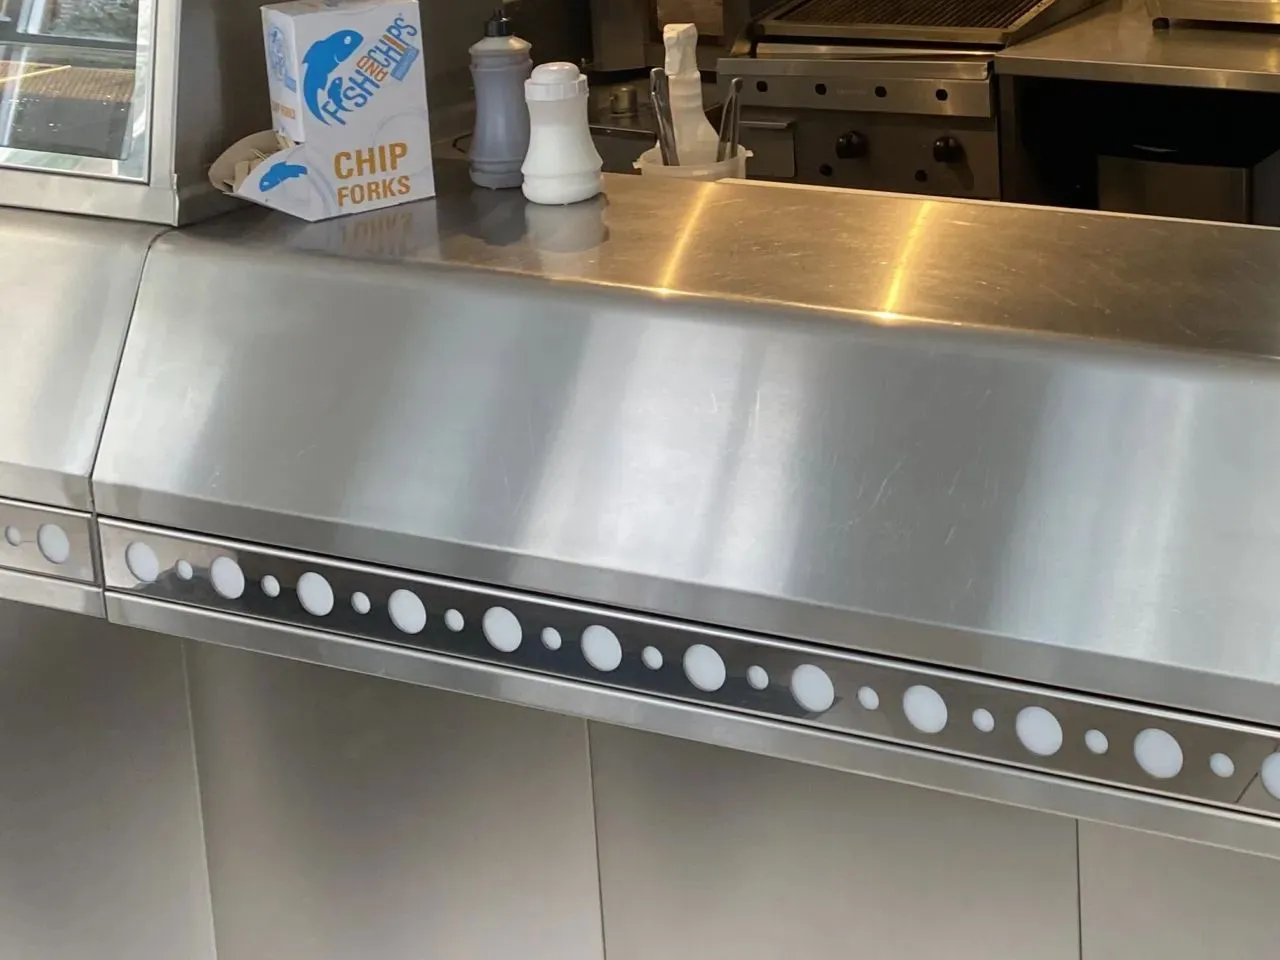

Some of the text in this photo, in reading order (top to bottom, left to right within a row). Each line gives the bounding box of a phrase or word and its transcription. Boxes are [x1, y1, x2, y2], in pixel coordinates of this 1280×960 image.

[368, 16, 418, 68] CHIPS
[334, 142, 408, 180] CHIP
[337, 175, 411, 207] FORKS
